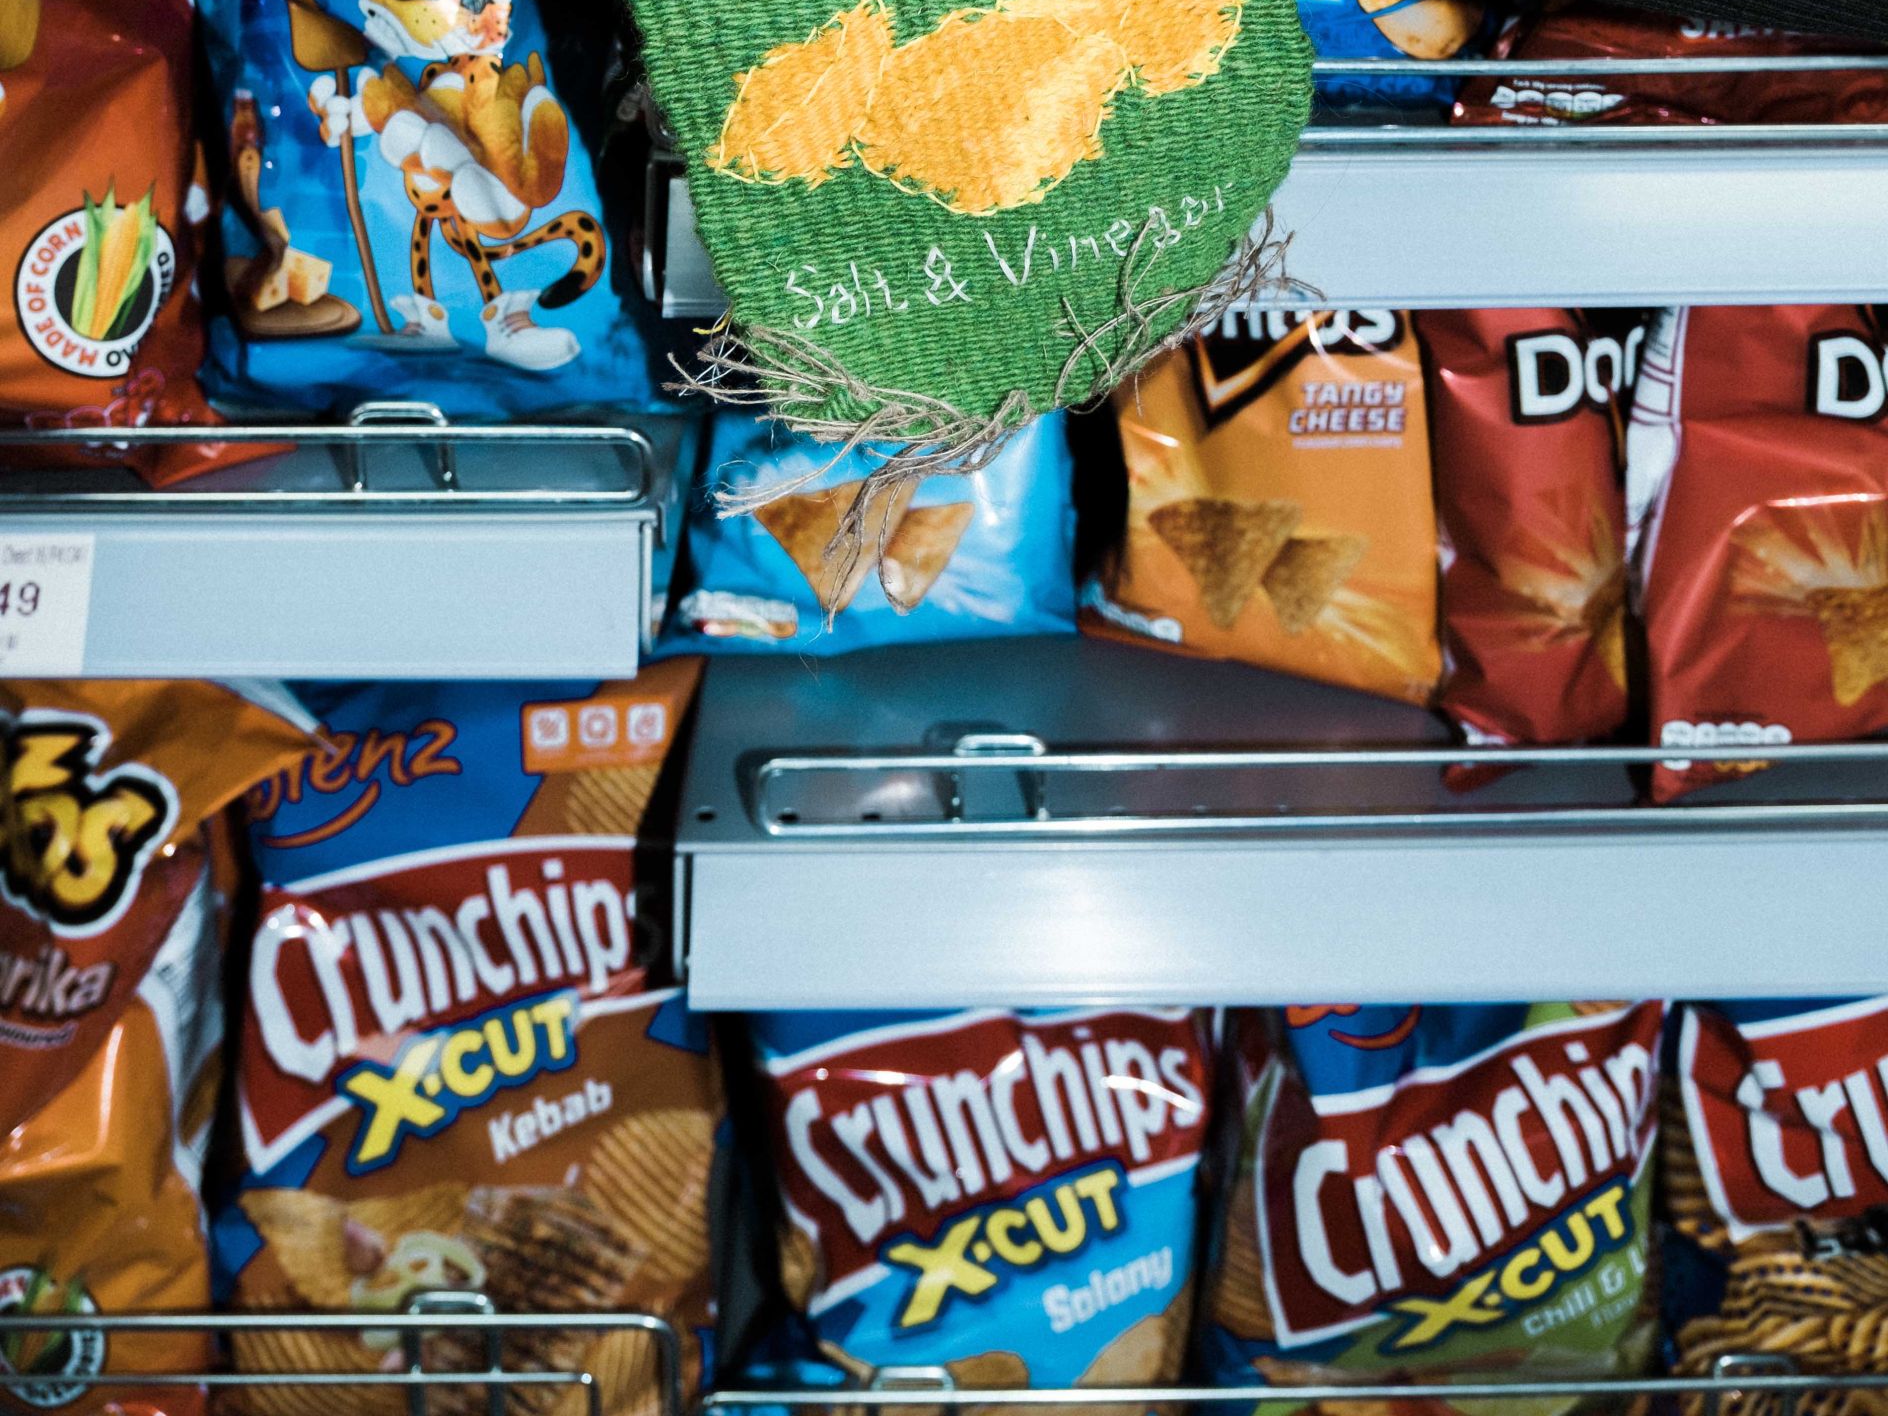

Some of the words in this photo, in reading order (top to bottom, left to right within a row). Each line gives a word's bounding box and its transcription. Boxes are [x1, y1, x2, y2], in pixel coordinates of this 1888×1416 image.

[30, 220, 83, 277] CORN
[25, 283, 47, 313] OF
[786, 260, 908, 329] Salt
[923, 246, 972, 306] &
[36, 318, 99, 367] MADE
[1288, 408, 1405, 434] CHEESE
[1303, 382, 1405, 406] TANGY
[250, 859, 640, 1084] Crunchip
[488, 1078, 613, 1163] Kebab
[785, 1027, 1203, 1245] Crunchips
